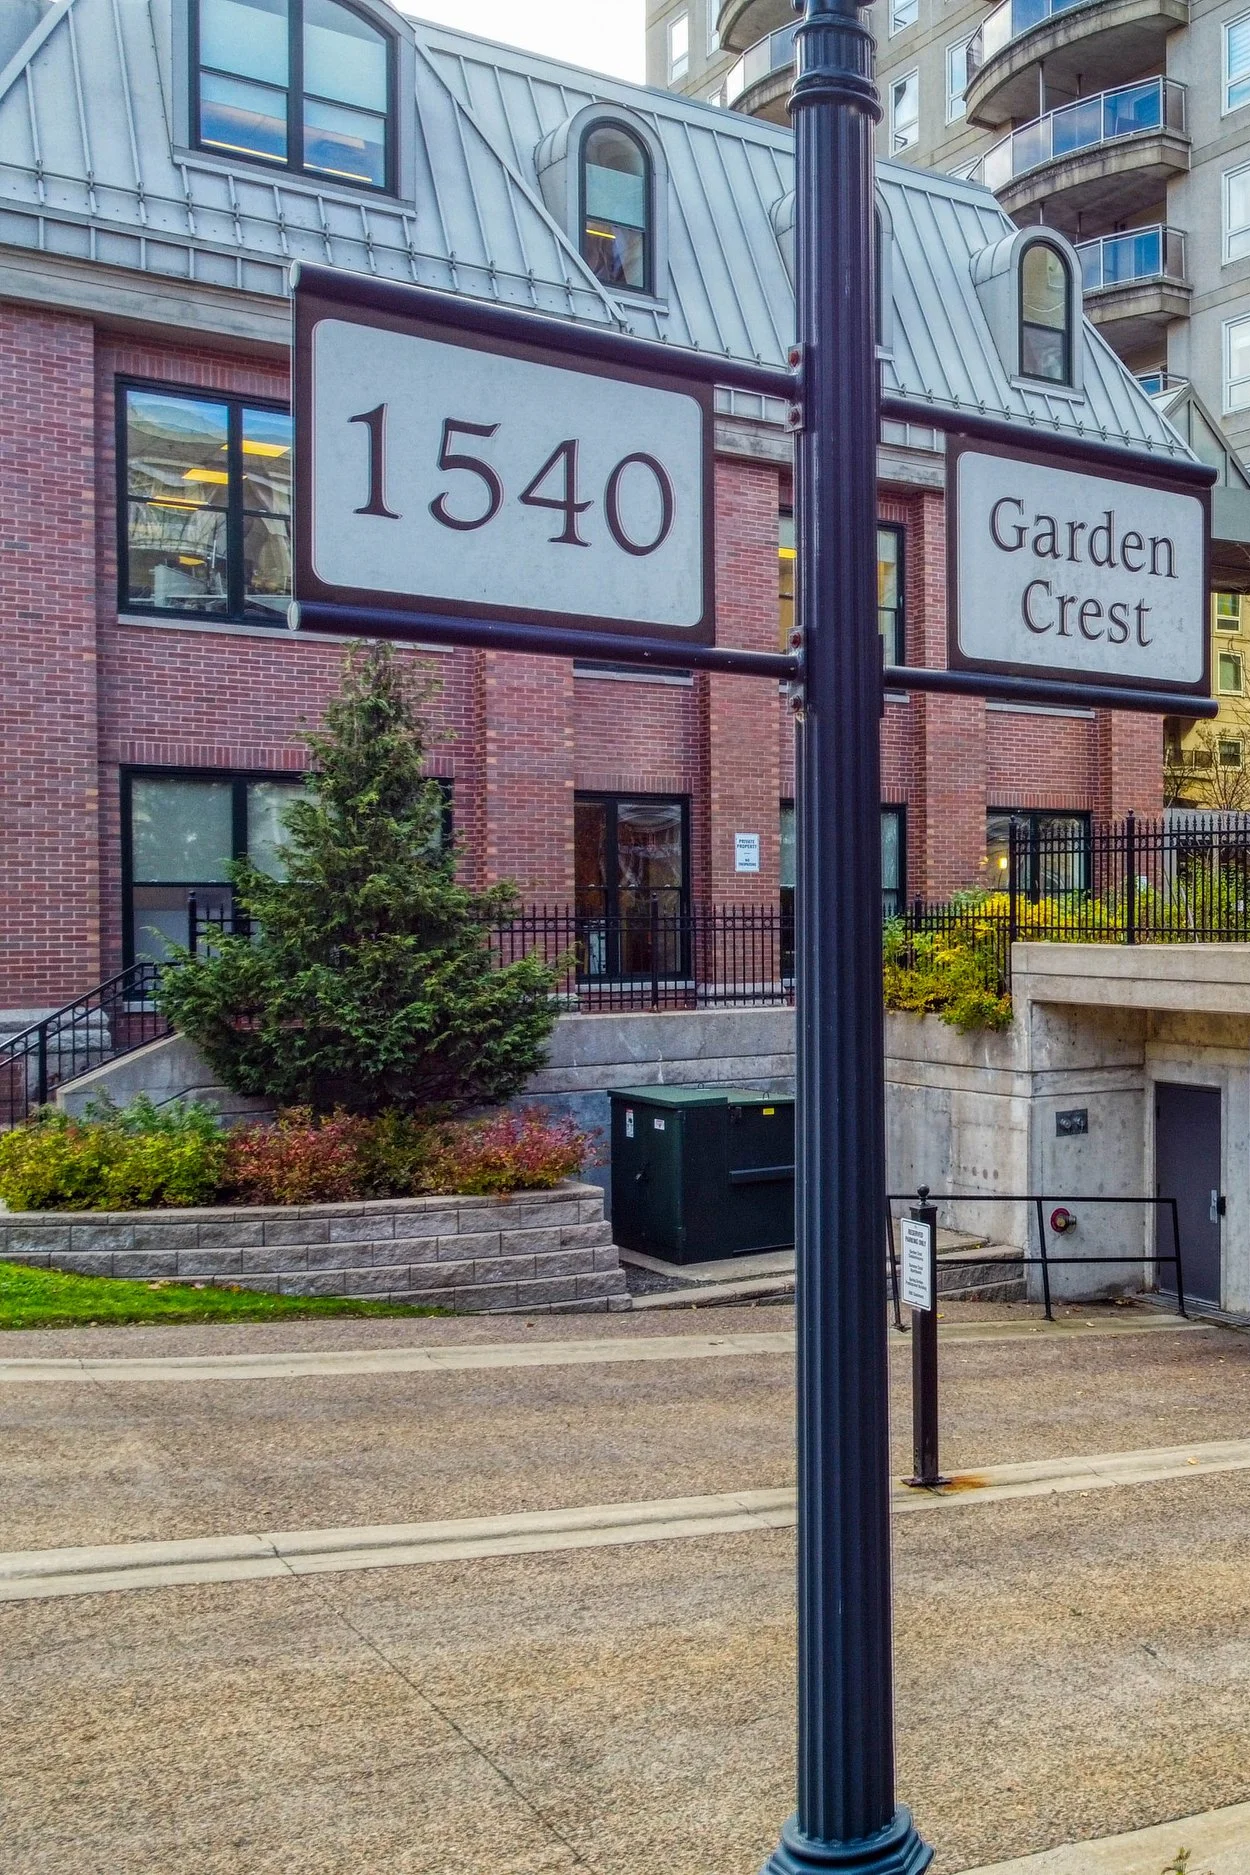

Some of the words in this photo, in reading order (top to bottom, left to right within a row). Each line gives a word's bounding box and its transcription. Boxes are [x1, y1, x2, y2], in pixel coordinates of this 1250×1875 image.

[348, 402, 676, 557] 1540
[989, 496, 1179, 579] Garden
[1021, 579, 1153, 647] Crest
[905, 1235, 919, 1245] PARKING
